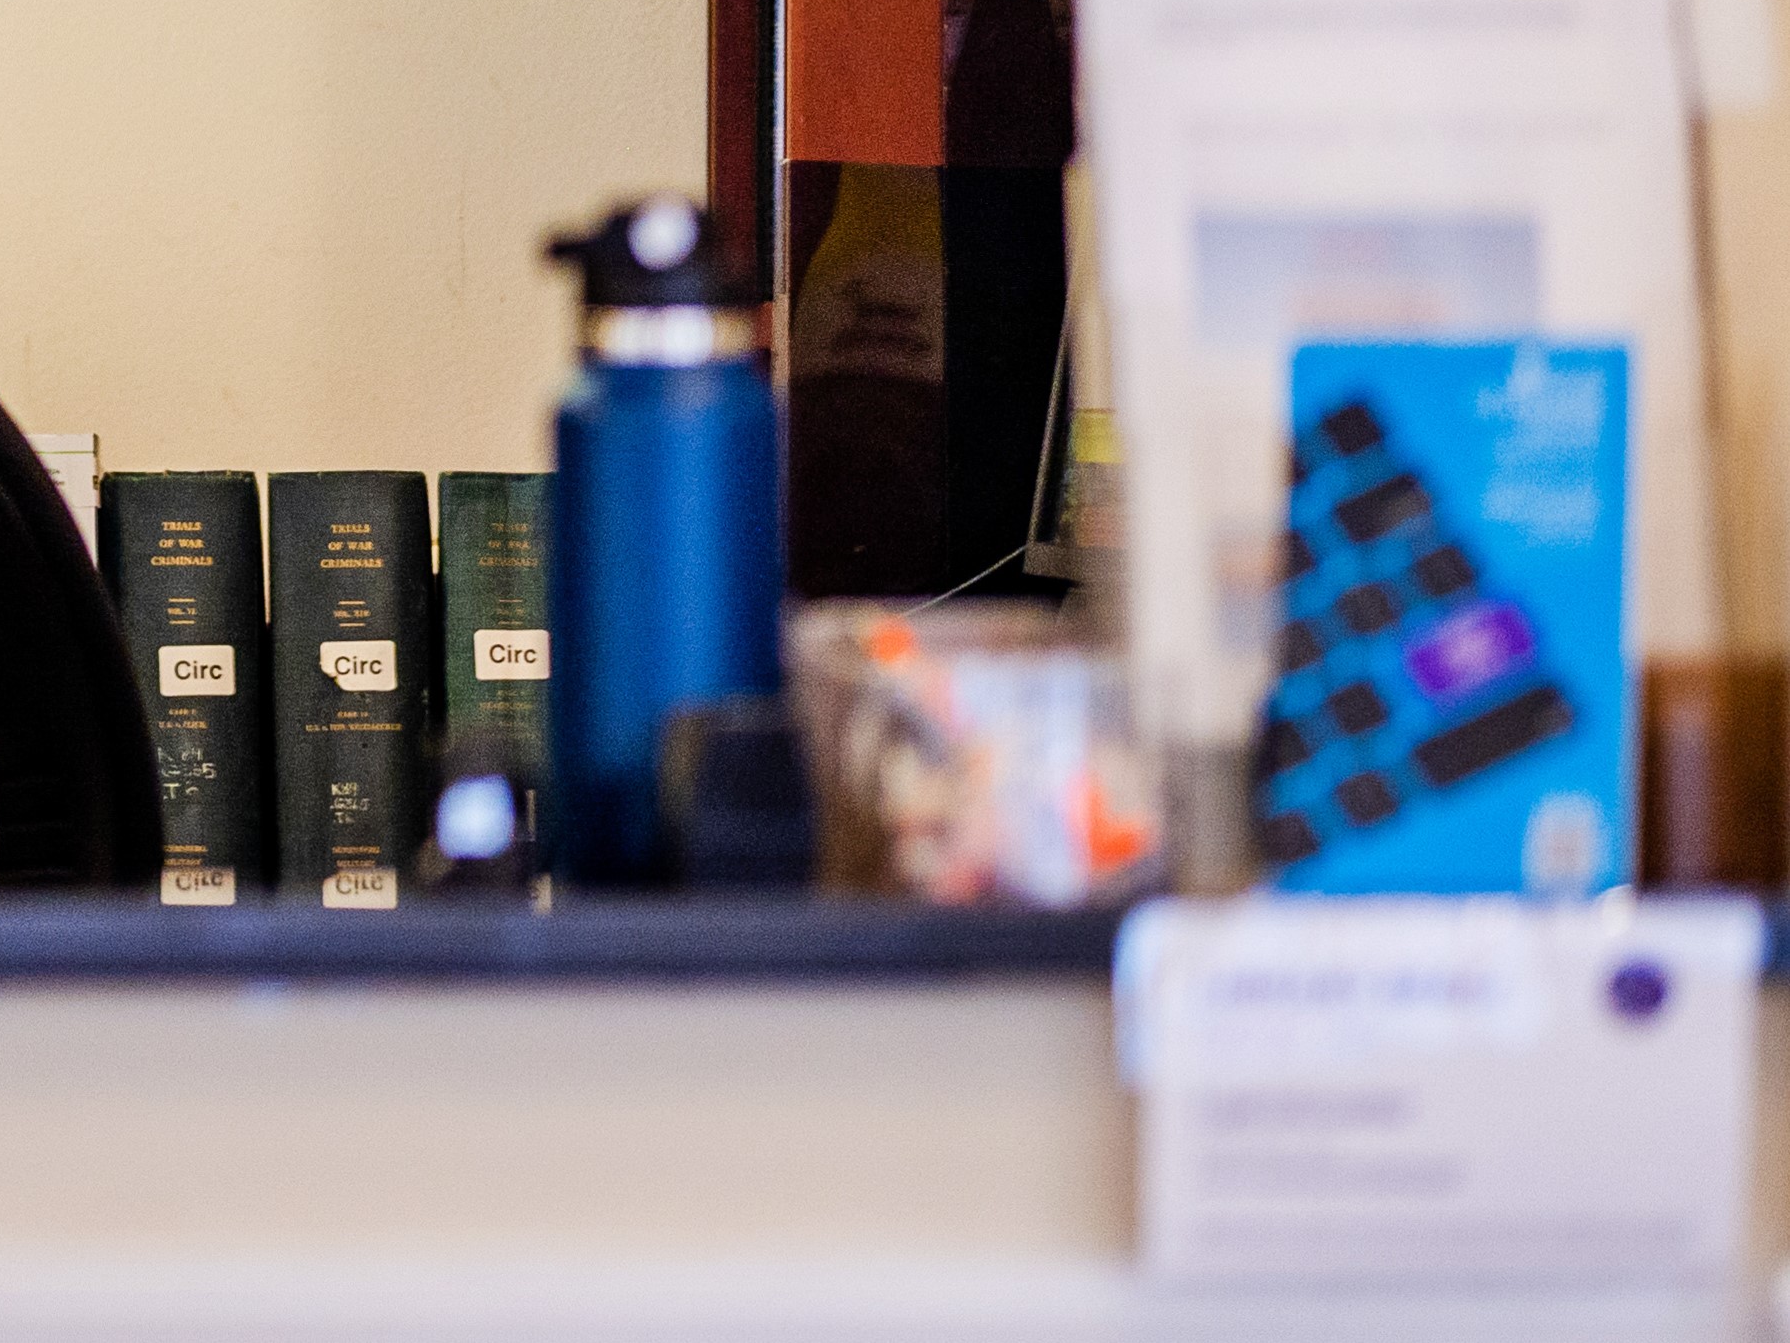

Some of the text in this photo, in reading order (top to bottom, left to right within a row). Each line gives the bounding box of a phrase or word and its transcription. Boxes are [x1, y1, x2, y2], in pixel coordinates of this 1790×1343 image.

[162, 521, 202, 531] TRIALS
[331, 523, 370, 534] TRIALS
[159, 539, 204, 548] OF WAR
[328, 541, 374, 551] OF WAR
[151, 556, 213, 566] CRIMINALS
[320, 558, 383, 569] CRIMINALS
[489, 644, 537, 664] Circ
[174, 660, 222, 680] Circ
[335, 656, 382, 675] Circ
